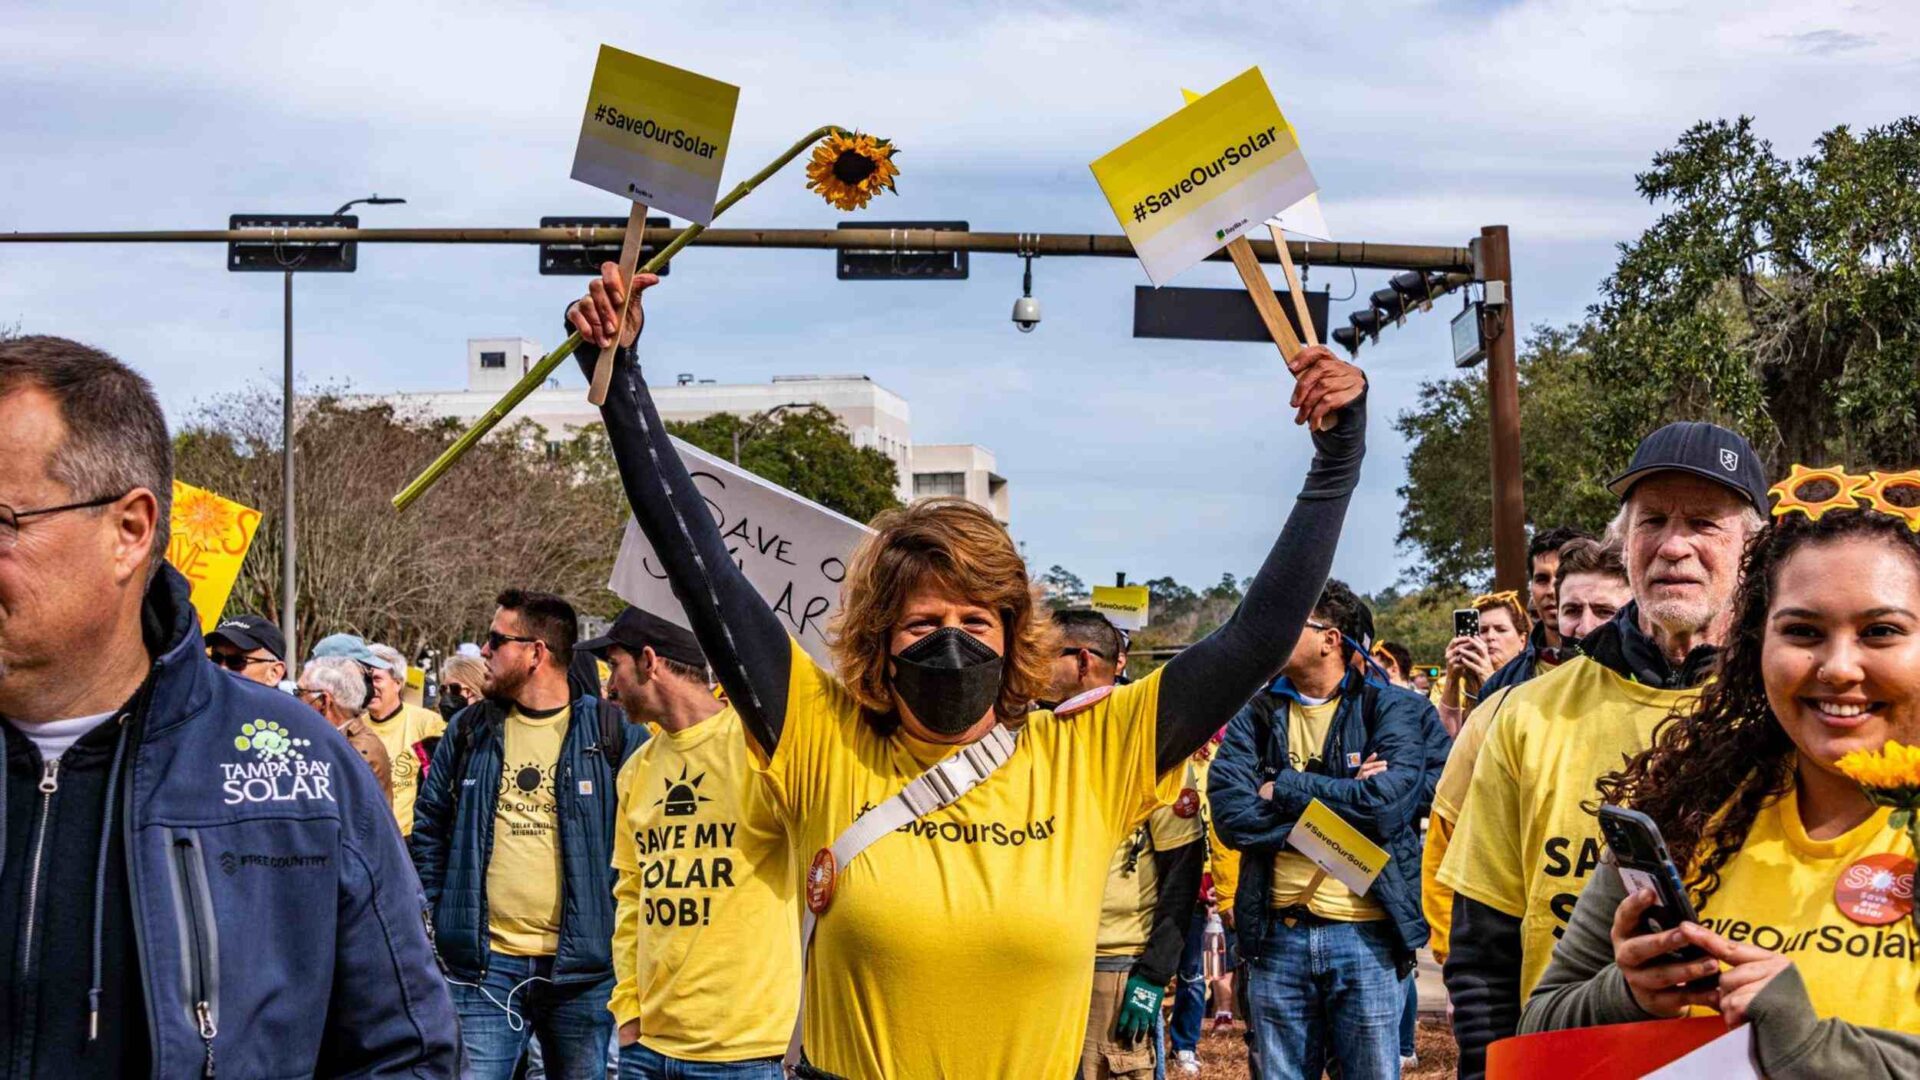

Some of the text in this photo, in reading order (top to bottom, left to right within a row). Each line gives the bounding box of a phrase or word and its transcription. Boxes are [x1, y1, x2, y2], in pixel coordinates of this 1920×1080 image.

[594, 104, 717, 159] #SaveOurSolar
[1133, 126, 1277, 223] #SaveOurSolar
[220, 760, 331, 780] TAMPA BAY
[223, 775, 336, 805] SOLAR
[516, 802, 539, 812] Our
[635, 822, 737, 855] SAVE MY
[854, 801, 1056, 846] aveOurSolar
[1304, 821, 1372, 874] #SaveOurSolar
[1543, 836, 1599, 878] SA
[638, 857, 736, 888] OLAR
[645, 896, 711, 927] JOB!
[1852, 904, 1884, 919] Solar
[1860, 891, 1889, 904] Save
[1699, 917, 1920, 963] aveOurSolar
